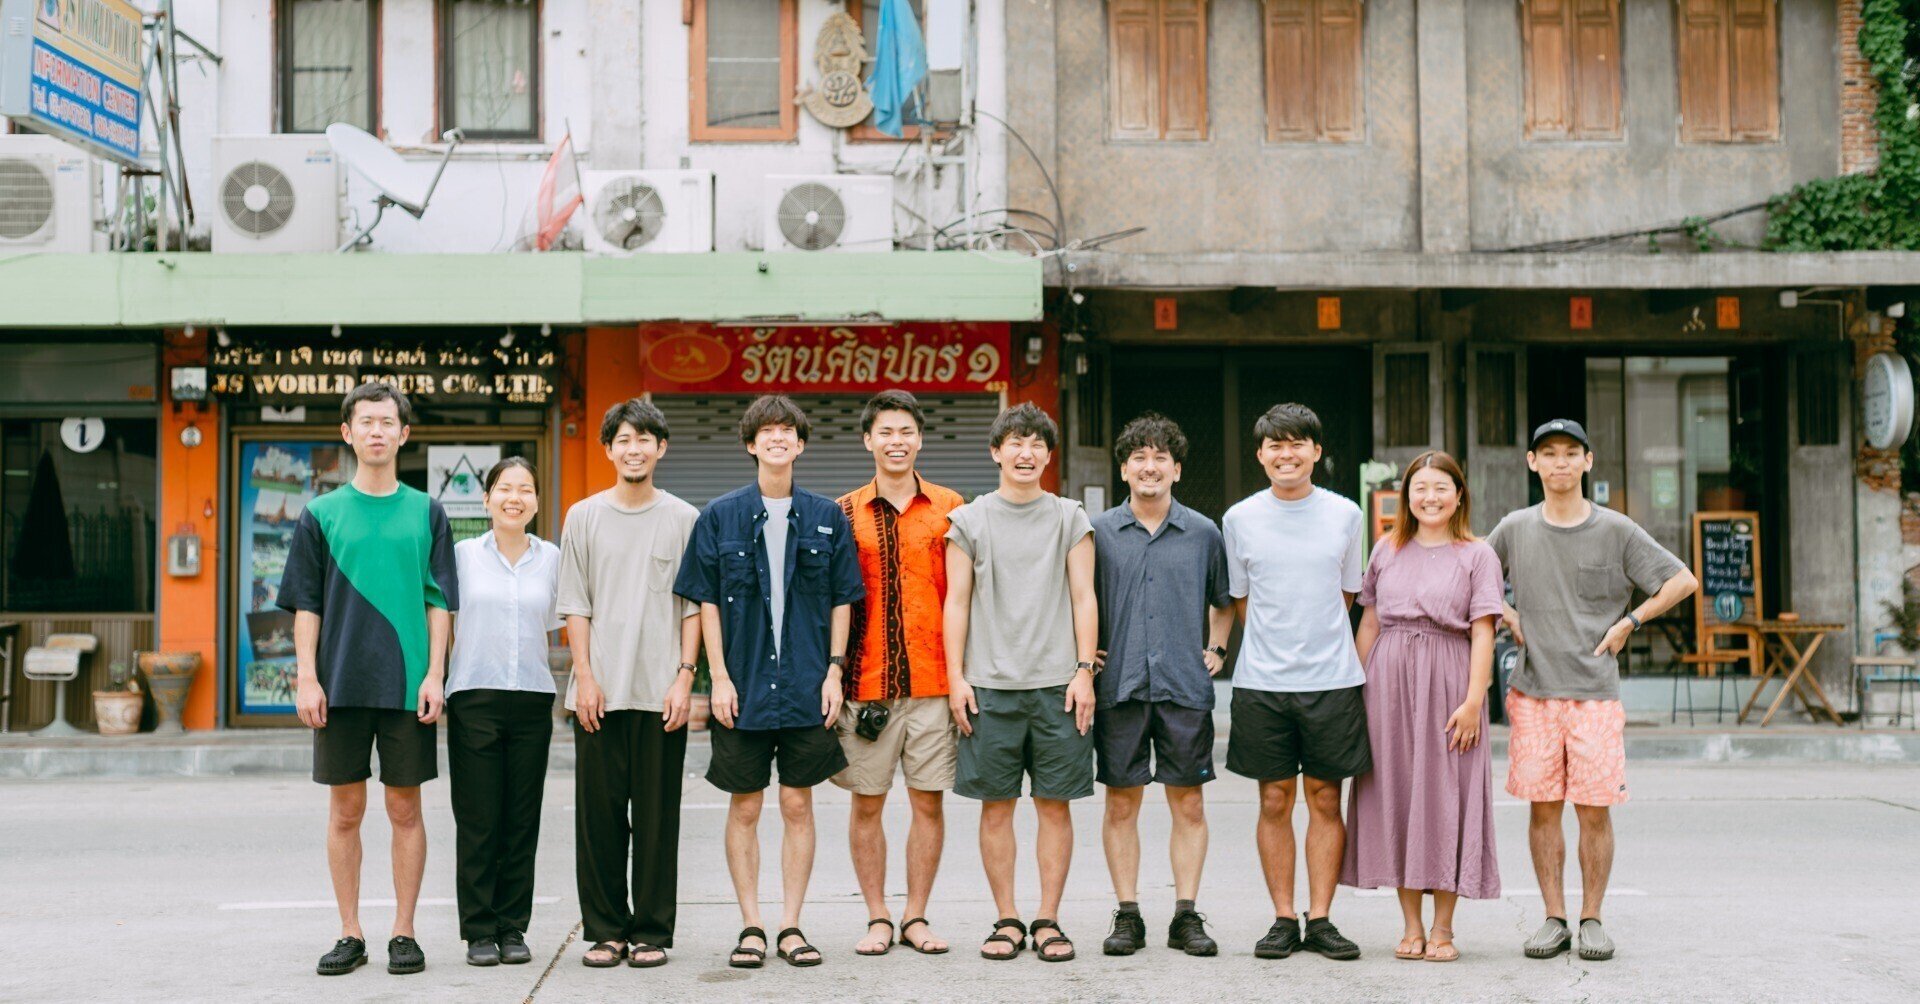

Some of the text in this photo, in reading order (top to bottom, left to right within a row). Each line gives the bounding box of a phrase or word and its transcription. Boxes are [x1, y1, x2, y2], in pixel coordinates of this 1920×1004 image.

[77, 0, 111, 50] WORLD
[113, 11, 139, 65] TOUR
[103, 81, 138, 123] CENTER
[210, 374, 244, 393] JS
[252, 373, 355, 394] WORLD
[360, 373, 435, 395] TOUR
